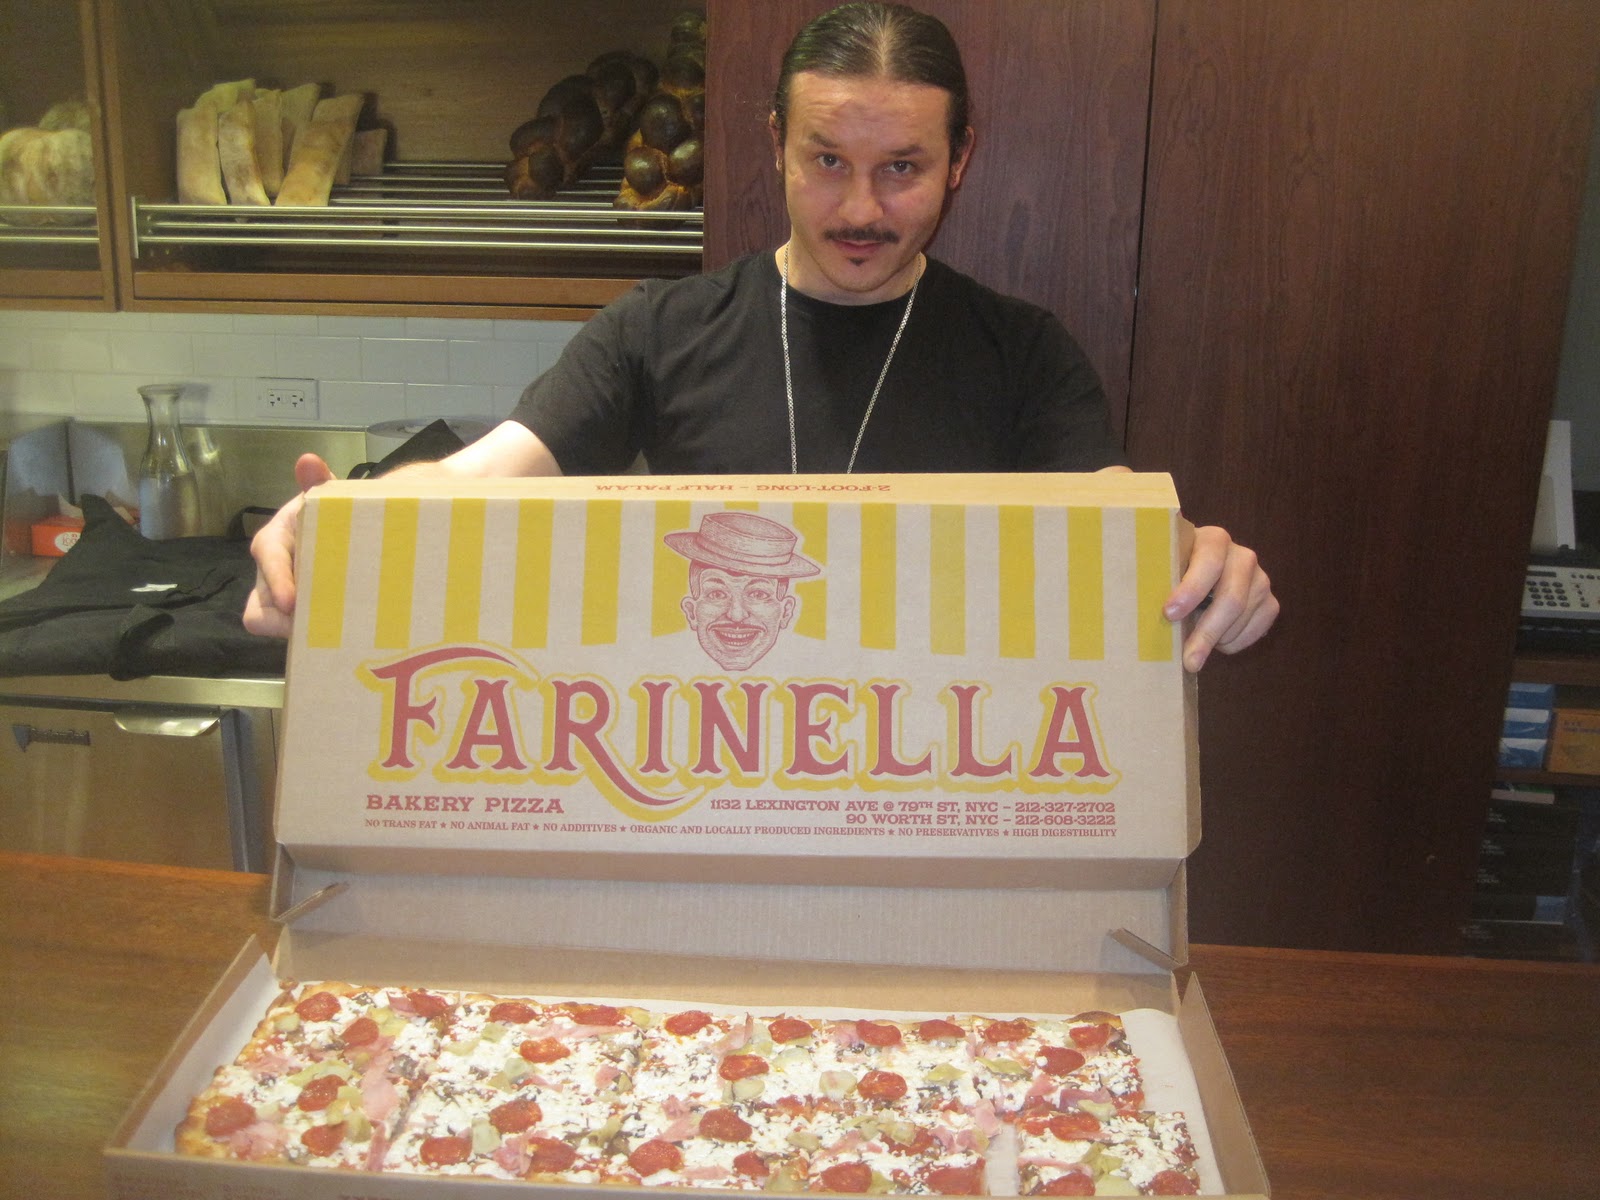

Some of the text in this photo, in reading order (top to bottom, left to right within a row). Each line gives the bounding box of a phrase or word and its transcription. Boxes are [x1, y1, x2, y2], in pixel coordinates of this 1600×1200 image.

[595, 484, 673, 492] PALAM
[677, 484, 734, 492] HALF
[370, 646, 1113, 807] FARINELLA
[366, 794, 565, 814] BAKERY PIZZA
[710, 799, 742, 810] 1132
[745, 799, 840, 812] LEXINGTON
[845, 800, 879, 812] AVE
[883, 801, 895, 812] @
[964, 801, 999, 813] NYC
[1014, 802, 1116, 813] 212-327-2702
[845, 813, 868, 825] 90
[872, 814, 933, 825] WORTH
[964, 814, 999, 826] NYC
[1014, 815, 1116, 826] 212-608-3222
[365, 818, 1117, 838] NO TRANS FAT NO ANIMAL FAT NO ADDITIVES ORGANIC AND LOCALLY PRODUCED INGREDIENTS NO PRESERVATIVES HIGH DIGESTIBILITY
